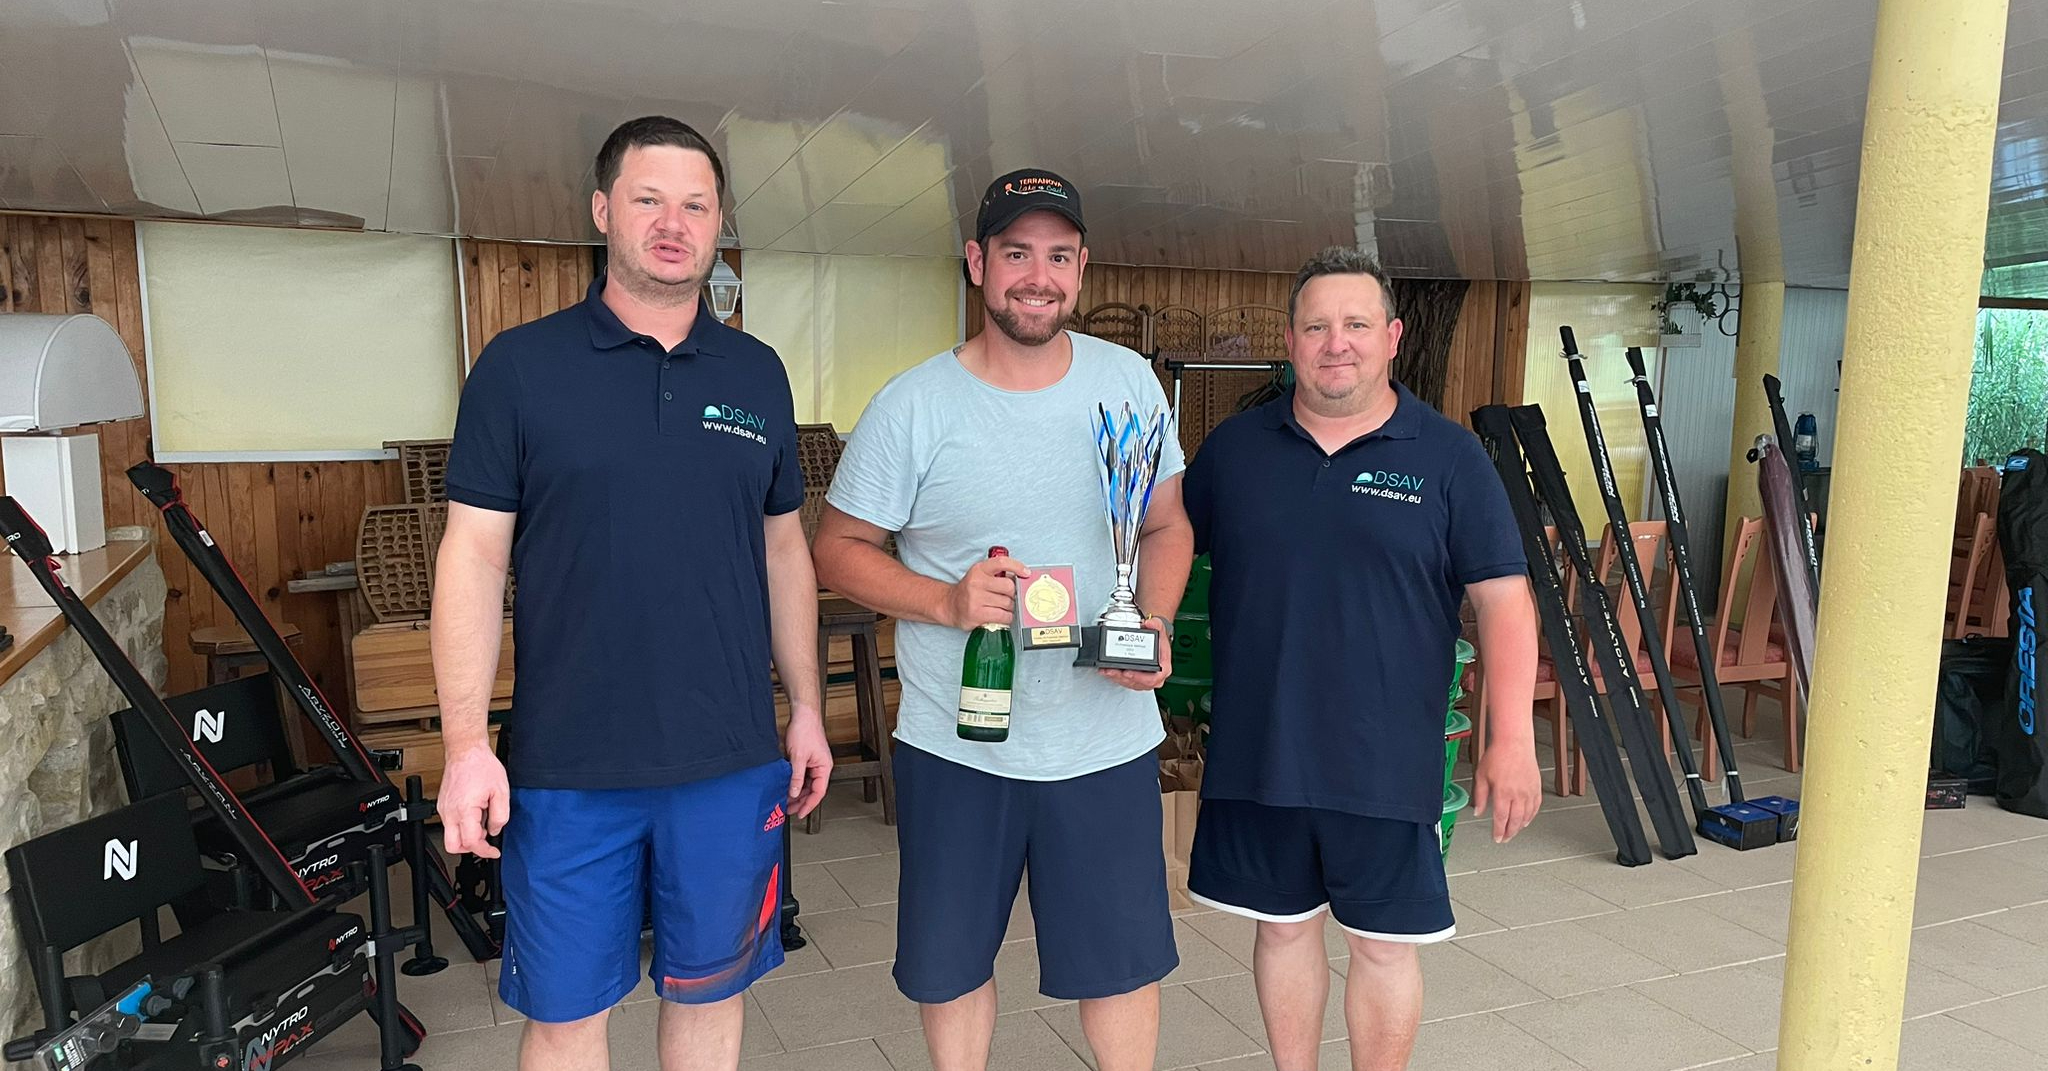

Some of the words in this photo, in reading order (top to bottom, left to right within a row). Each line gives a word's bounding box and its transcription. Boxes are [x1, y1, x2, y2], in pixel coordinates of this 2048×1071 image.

[721, 404, 766, 431] DSAV
[702, 421, 767, 445] www.dsav.eu
[1373, 470, 1424, 491] DSAV
[1351, 484, 1422, 504] www.dsav.eu
[2017, 586, 2037, 736] CRESTA
[303, 686, 348, 742] ARYZON
[366, 795, 390, 809] NYTRO
[335, 926, 358, 945] NYTRO
[261, 1005, 309, 1046] NYTRO
